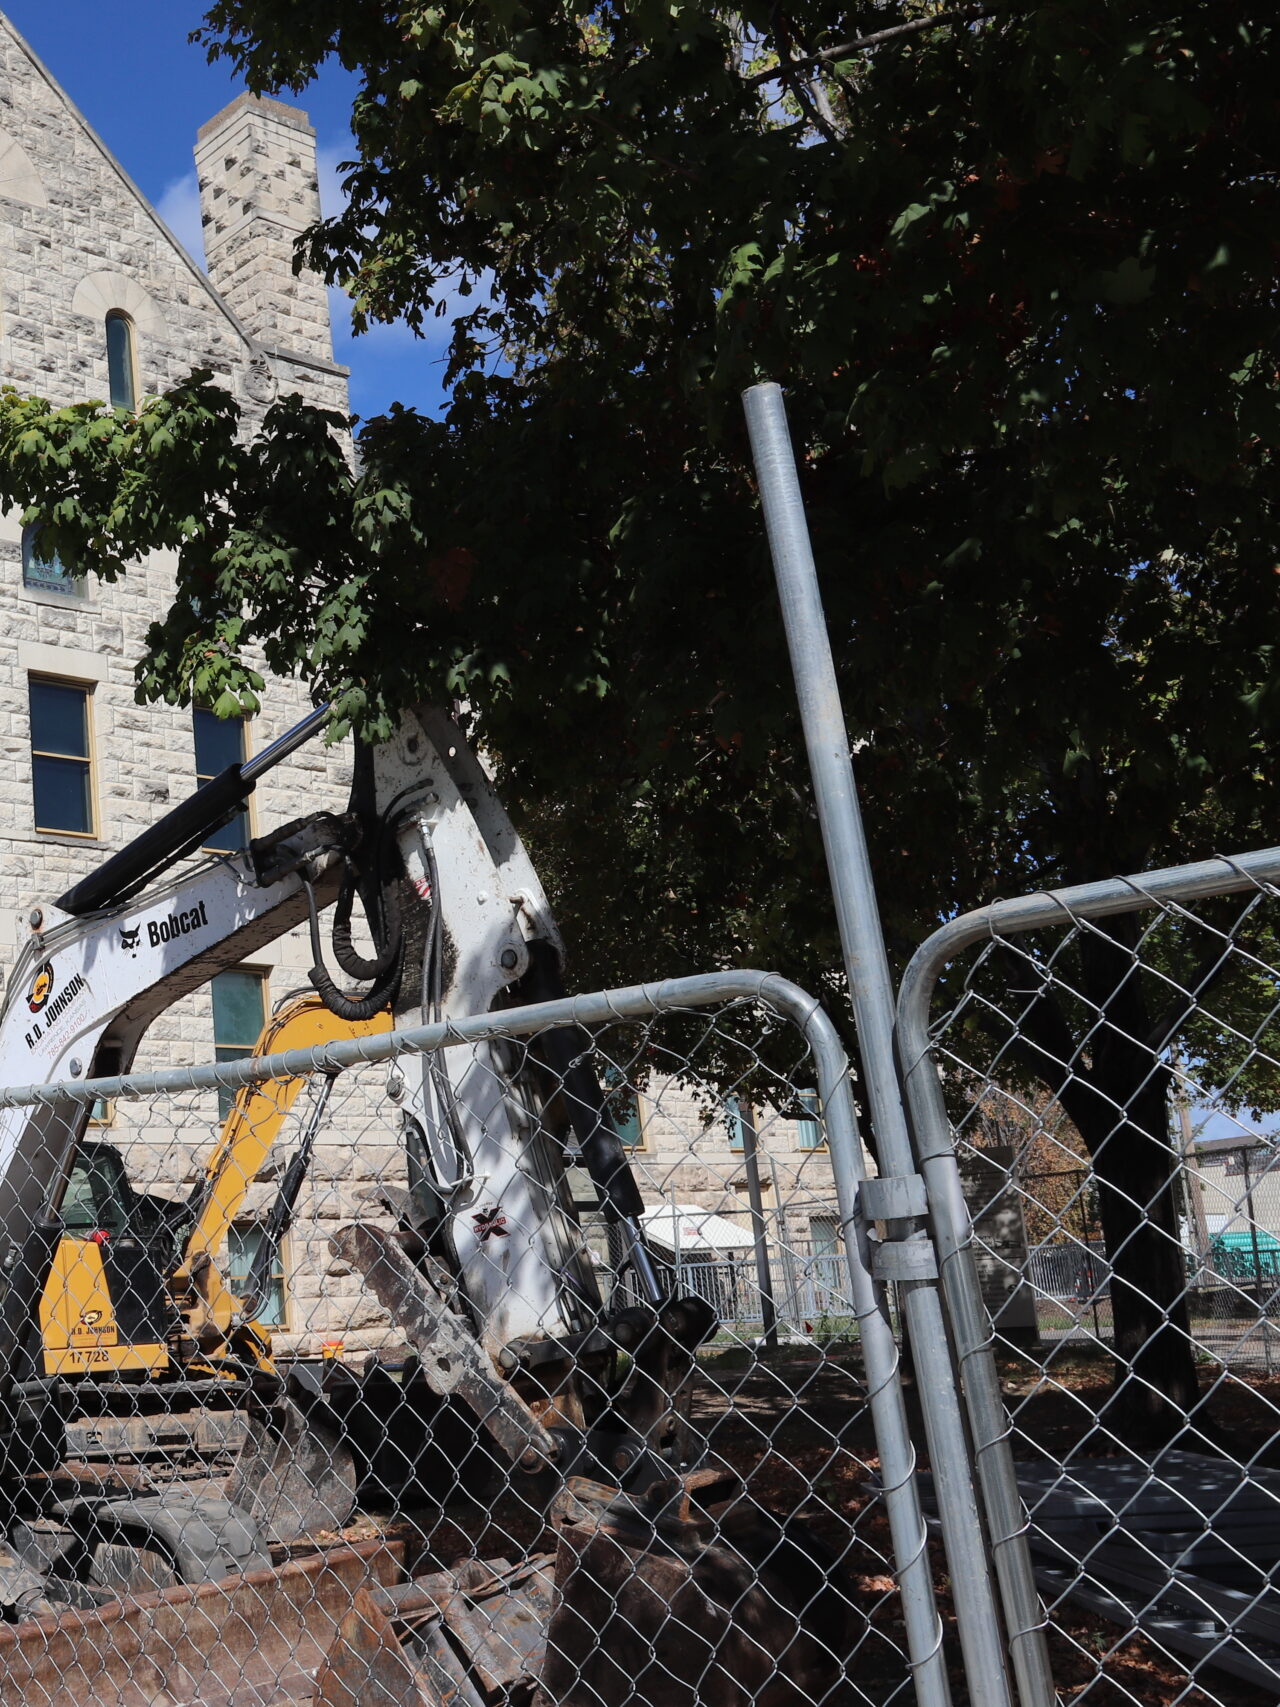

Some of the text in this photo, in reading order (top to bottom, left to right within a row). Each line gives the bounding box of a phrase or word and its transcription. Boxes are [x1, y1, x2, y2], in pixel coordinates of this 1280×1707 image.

[147, 900, 208, 948] Bobcat
[25, 972, 84, 1049] R.D. JOHNSON
[69, 1350, 109, 1364] 17728
